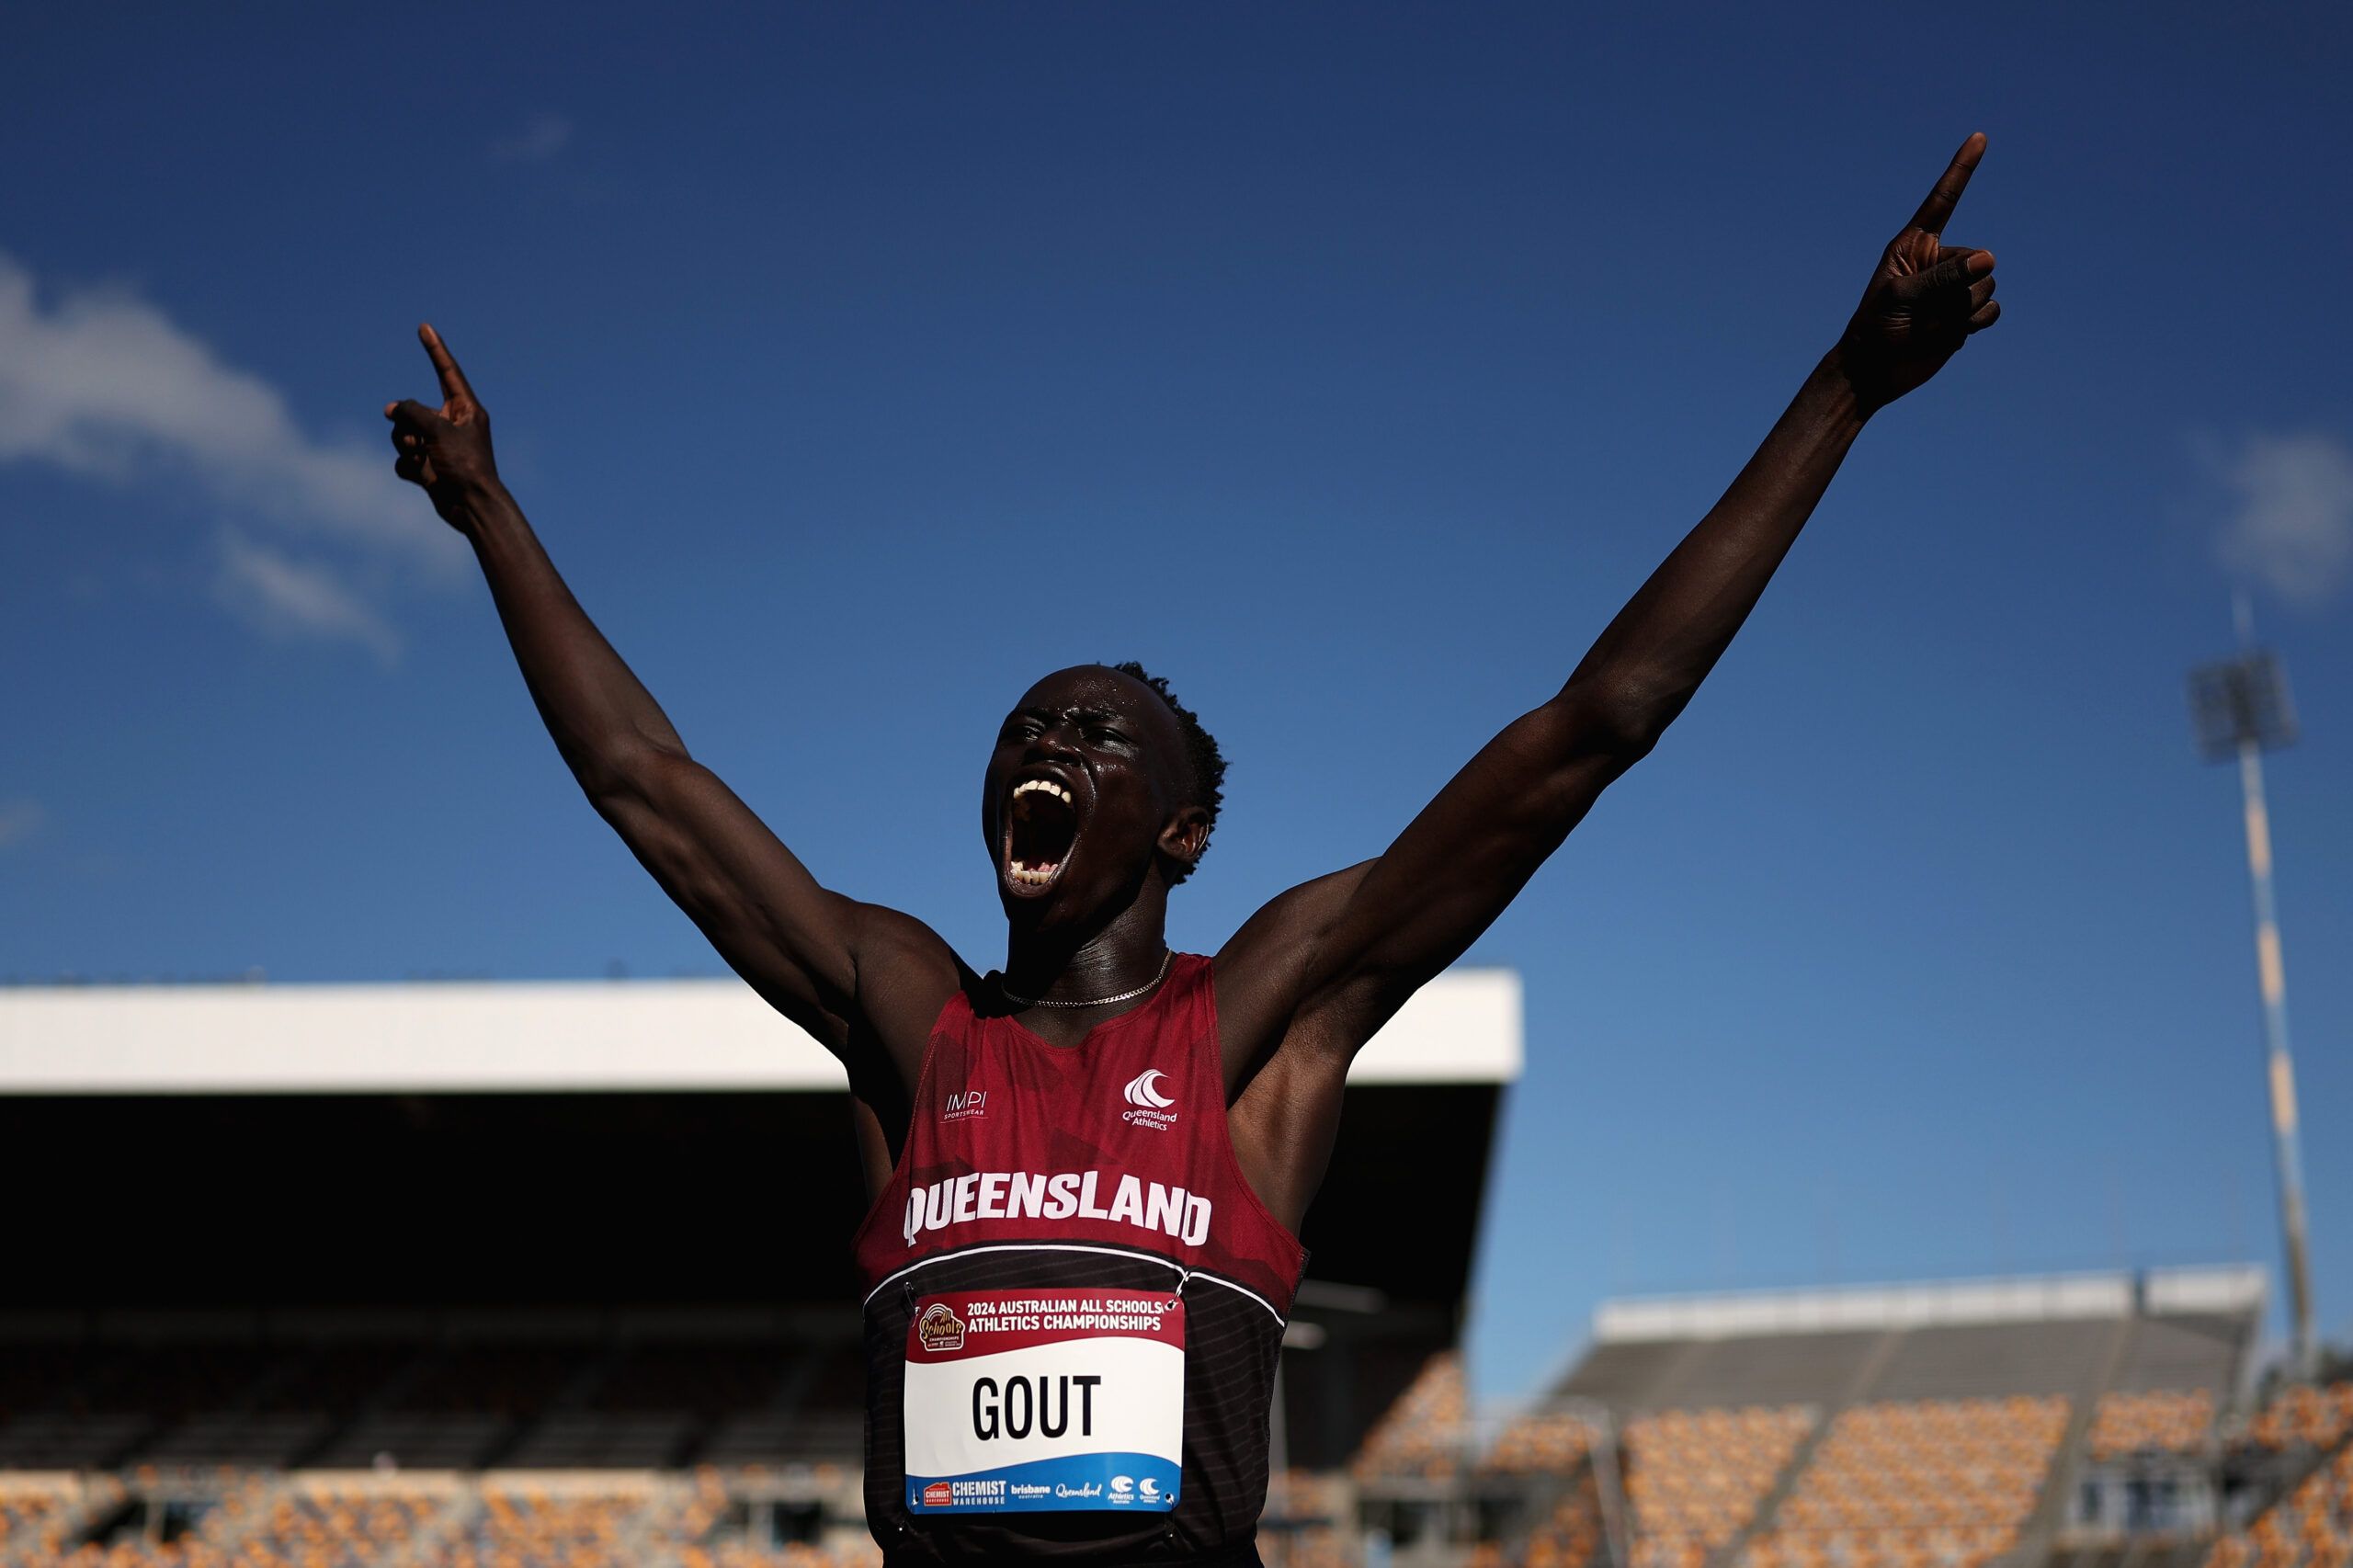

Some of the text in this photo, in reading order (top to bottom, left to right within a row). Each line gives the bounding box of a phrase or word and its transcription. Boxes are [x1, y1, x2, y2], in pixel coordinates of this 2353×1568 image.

[946, 1091, 987, 1112] IMPI
[943, 1108, 984, 1120] SPORTSWEAR
[1122, 1109, 1177, 1122] Queensland
[1131, 1117, 1167, 1131] Athletics
[903, 1170, 1212, 1248] QUEENSLAND
[967, 1299, 1163, 1316] 2024 AUSTRALIAN ALL SCHOOLS
[921, 1319, 962, 1340] Schools
[968, 1314, 1162, 1333] ATHLETICS CHAMPIONSHIPS
[972, 1375, 1102, 1441] GOUT
[925, 1490, 950, 1499] CHEMIST
[952, 1480, 1006, 1497] CHEMIST
[1011, 1483, 1051, 1494] brisbane
[1055, 1482, 1102, 1498] Queensland
[952, 1495, 1006, 1506] WAREHOUSE
